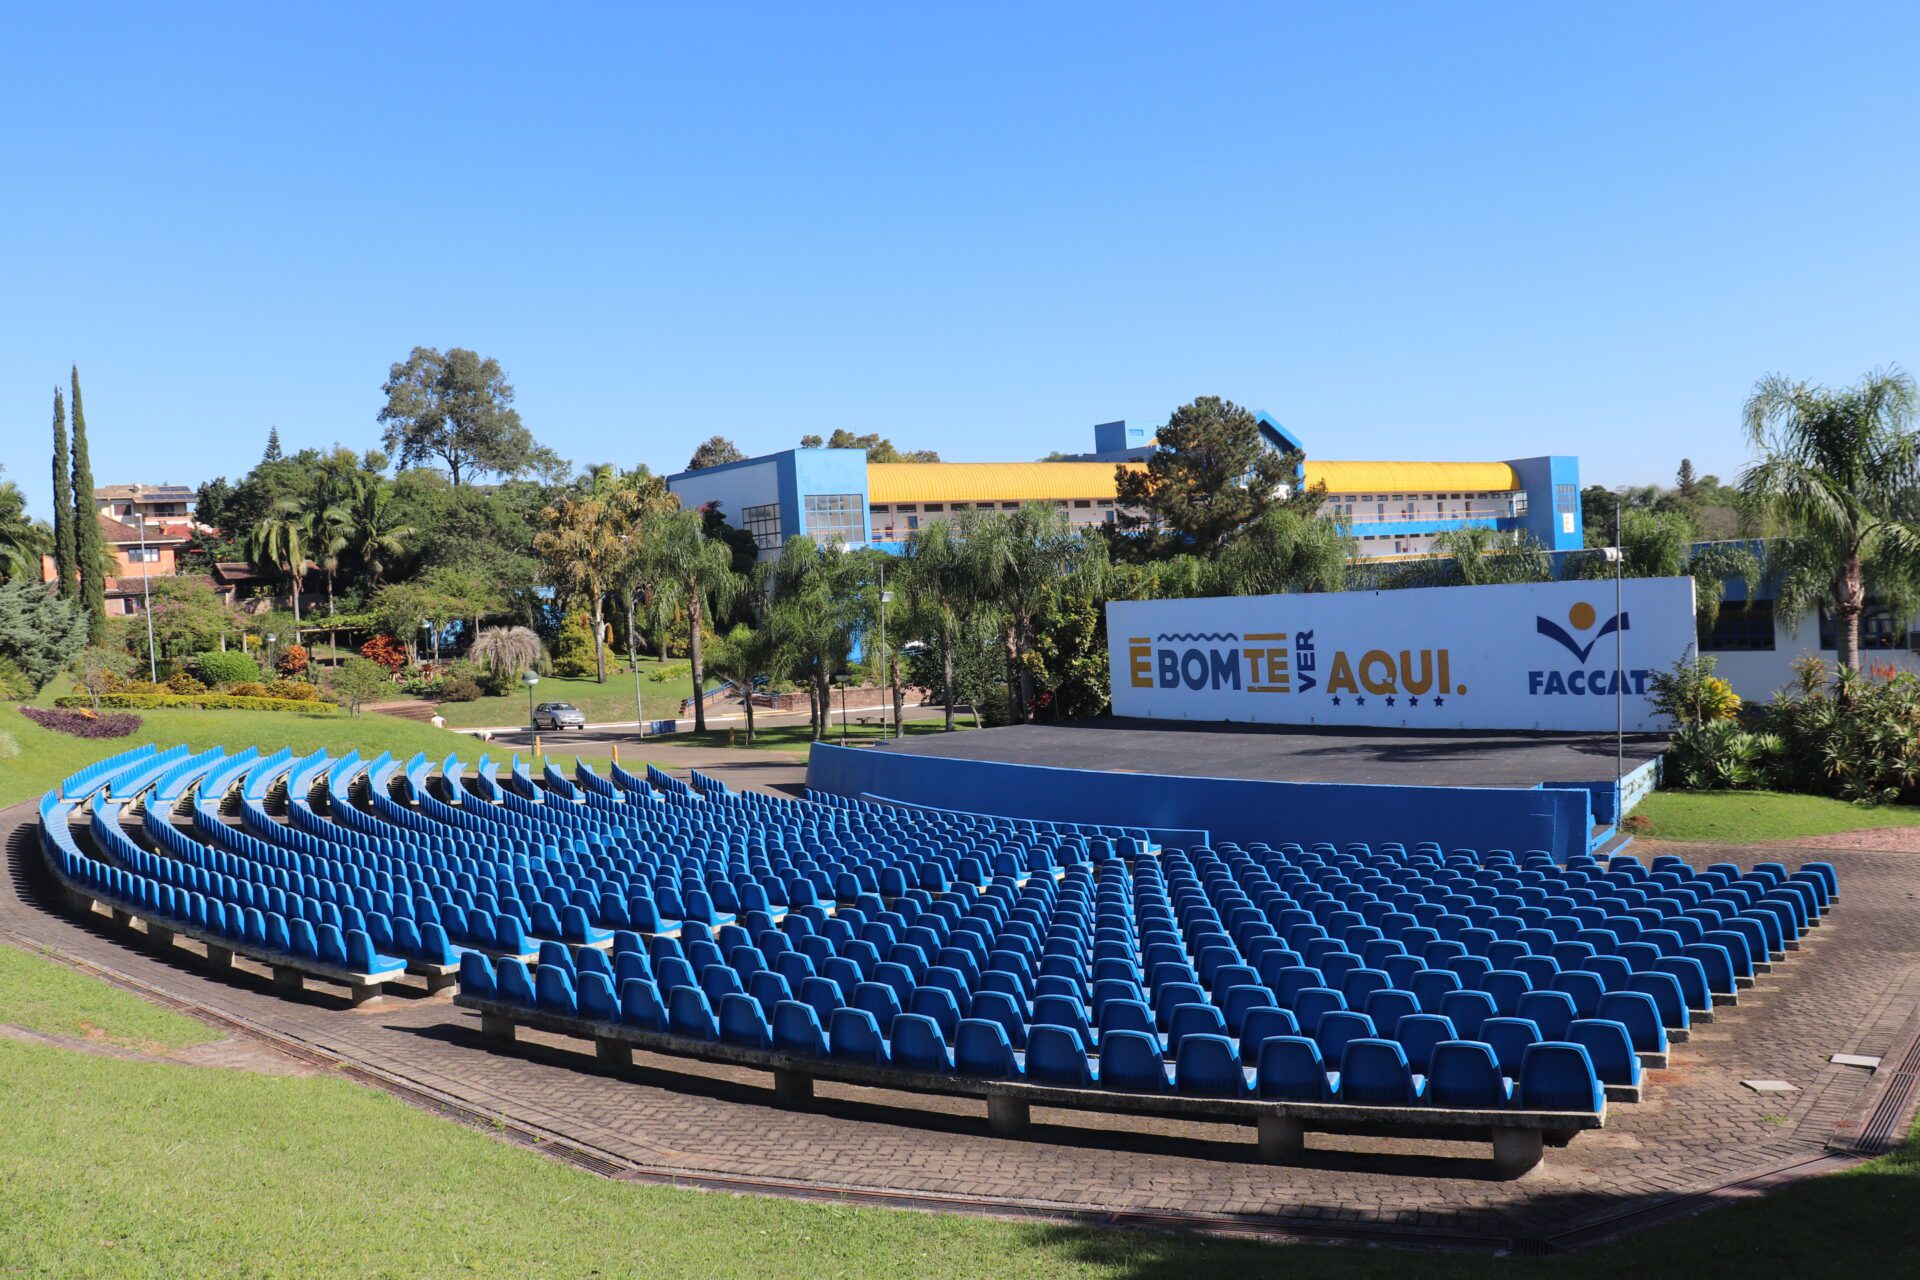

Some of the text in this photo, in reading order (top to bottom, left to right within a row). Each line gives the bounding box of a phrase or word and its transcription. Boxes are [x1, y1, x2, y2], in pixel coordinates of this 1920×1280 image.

[1157, 648, 1241, 691] BOM
[1244, 648, 1290, 683] TE
[1296, 629, 1317, 693] VER
[1326, 649, 1467, 695] AQUI.
[1528, 669, 1648, 695] FACCAT
